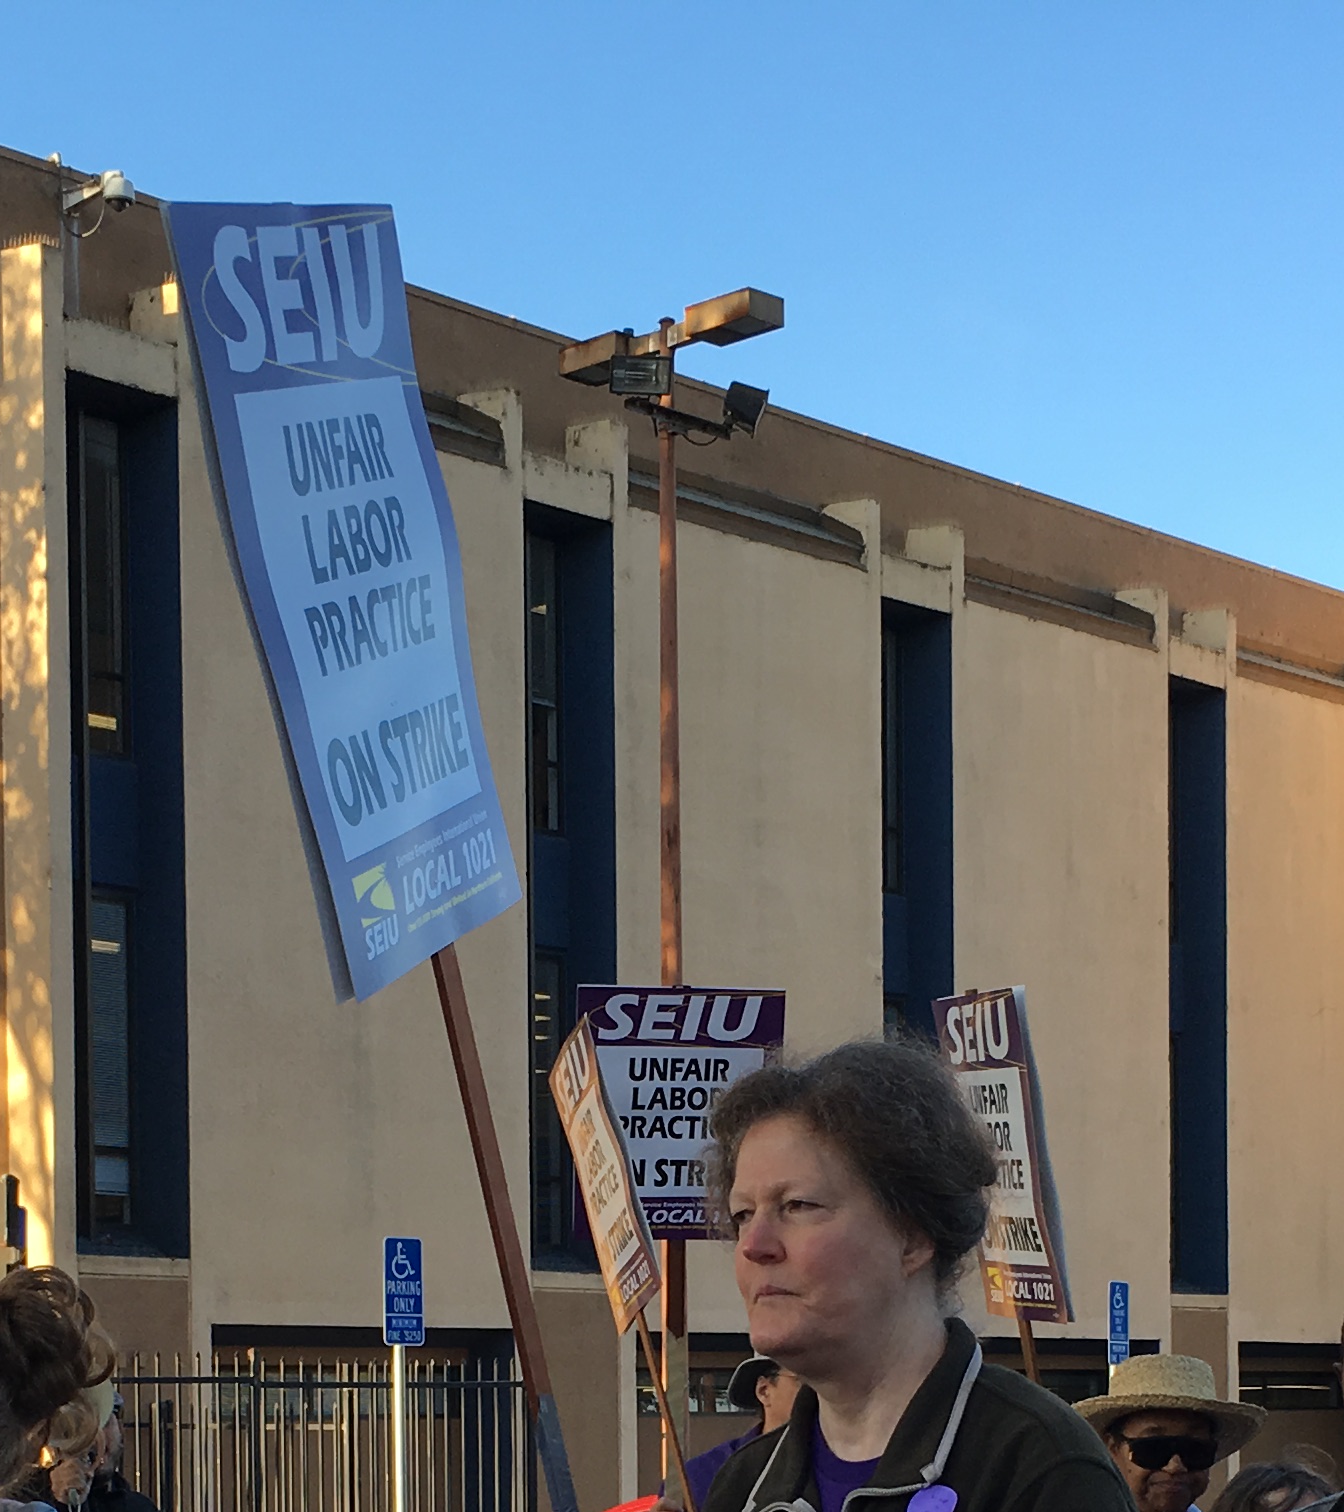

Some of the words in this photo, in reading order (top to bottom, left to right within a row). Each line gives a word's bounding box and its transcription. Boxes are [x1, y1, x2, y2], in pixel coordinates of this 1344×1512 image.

[213, 224, 385, 373] SEIU
[282, 413, 394, 496] UNFAIR
[301, 496, 412, 584] LABOR
[304, 574, 435, 677] PRACTICE
[327, 729, 387, 827] ON
[378, 693, 469, 803] STRIKE
[403, 849, 461, 915] LOCAL
[462, 828, 497, 879] 1021
[365, 914, 399, 961] SEIU
[597, 993, 764, 1042] SEIU
[946, 997, 1009, 1065] SEIU
[555, 1029, 590, 1125] SEIU
[629, 1057, 730, 1082] UNFAIR
[619, 1115, 715, 1140] RACTI
[653, 1158, 706, 1187] STR
[644, 1209, 707, 1224] LOCAL
[998, 1215, 1044, 1253] STRIKE
[387, 1279, 421, 1296] PARKING
[393, 1296, 415, 1313] ONLY
[1004, 1279, 1032, 1300] LOCAL
[1032, 1281, 1055, 1302] 1021
